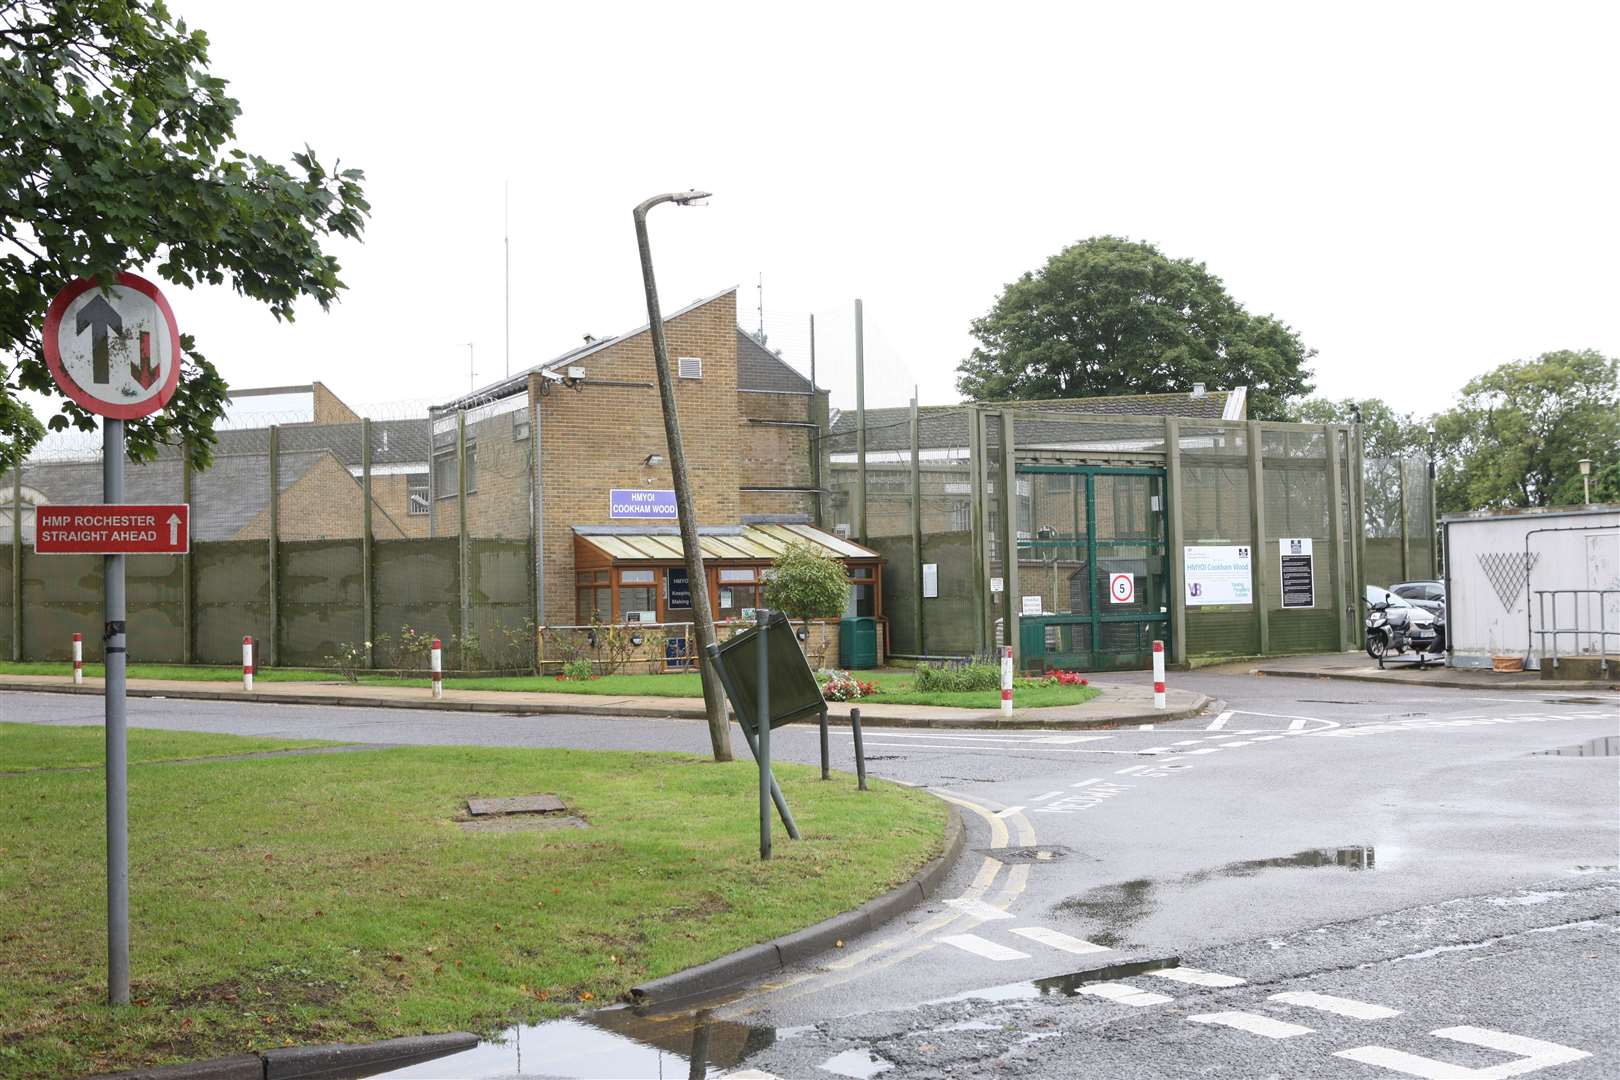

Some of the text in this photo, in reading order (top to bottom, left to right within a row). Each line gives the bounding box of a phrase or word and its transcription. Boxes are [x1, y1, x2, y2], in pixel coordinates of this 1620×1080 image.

[631, 492, 655, 502] HMYOI
[613, 504, 675, 514] COOKHAM WOOD
[42, 515, 156, 527] HMP ROCHESTER
[41, 530, 157, 542] STRAIGHT AHEAD
[1233, 563, 1248, 571] Wood
[1119, 583, 1125, 594] 5
